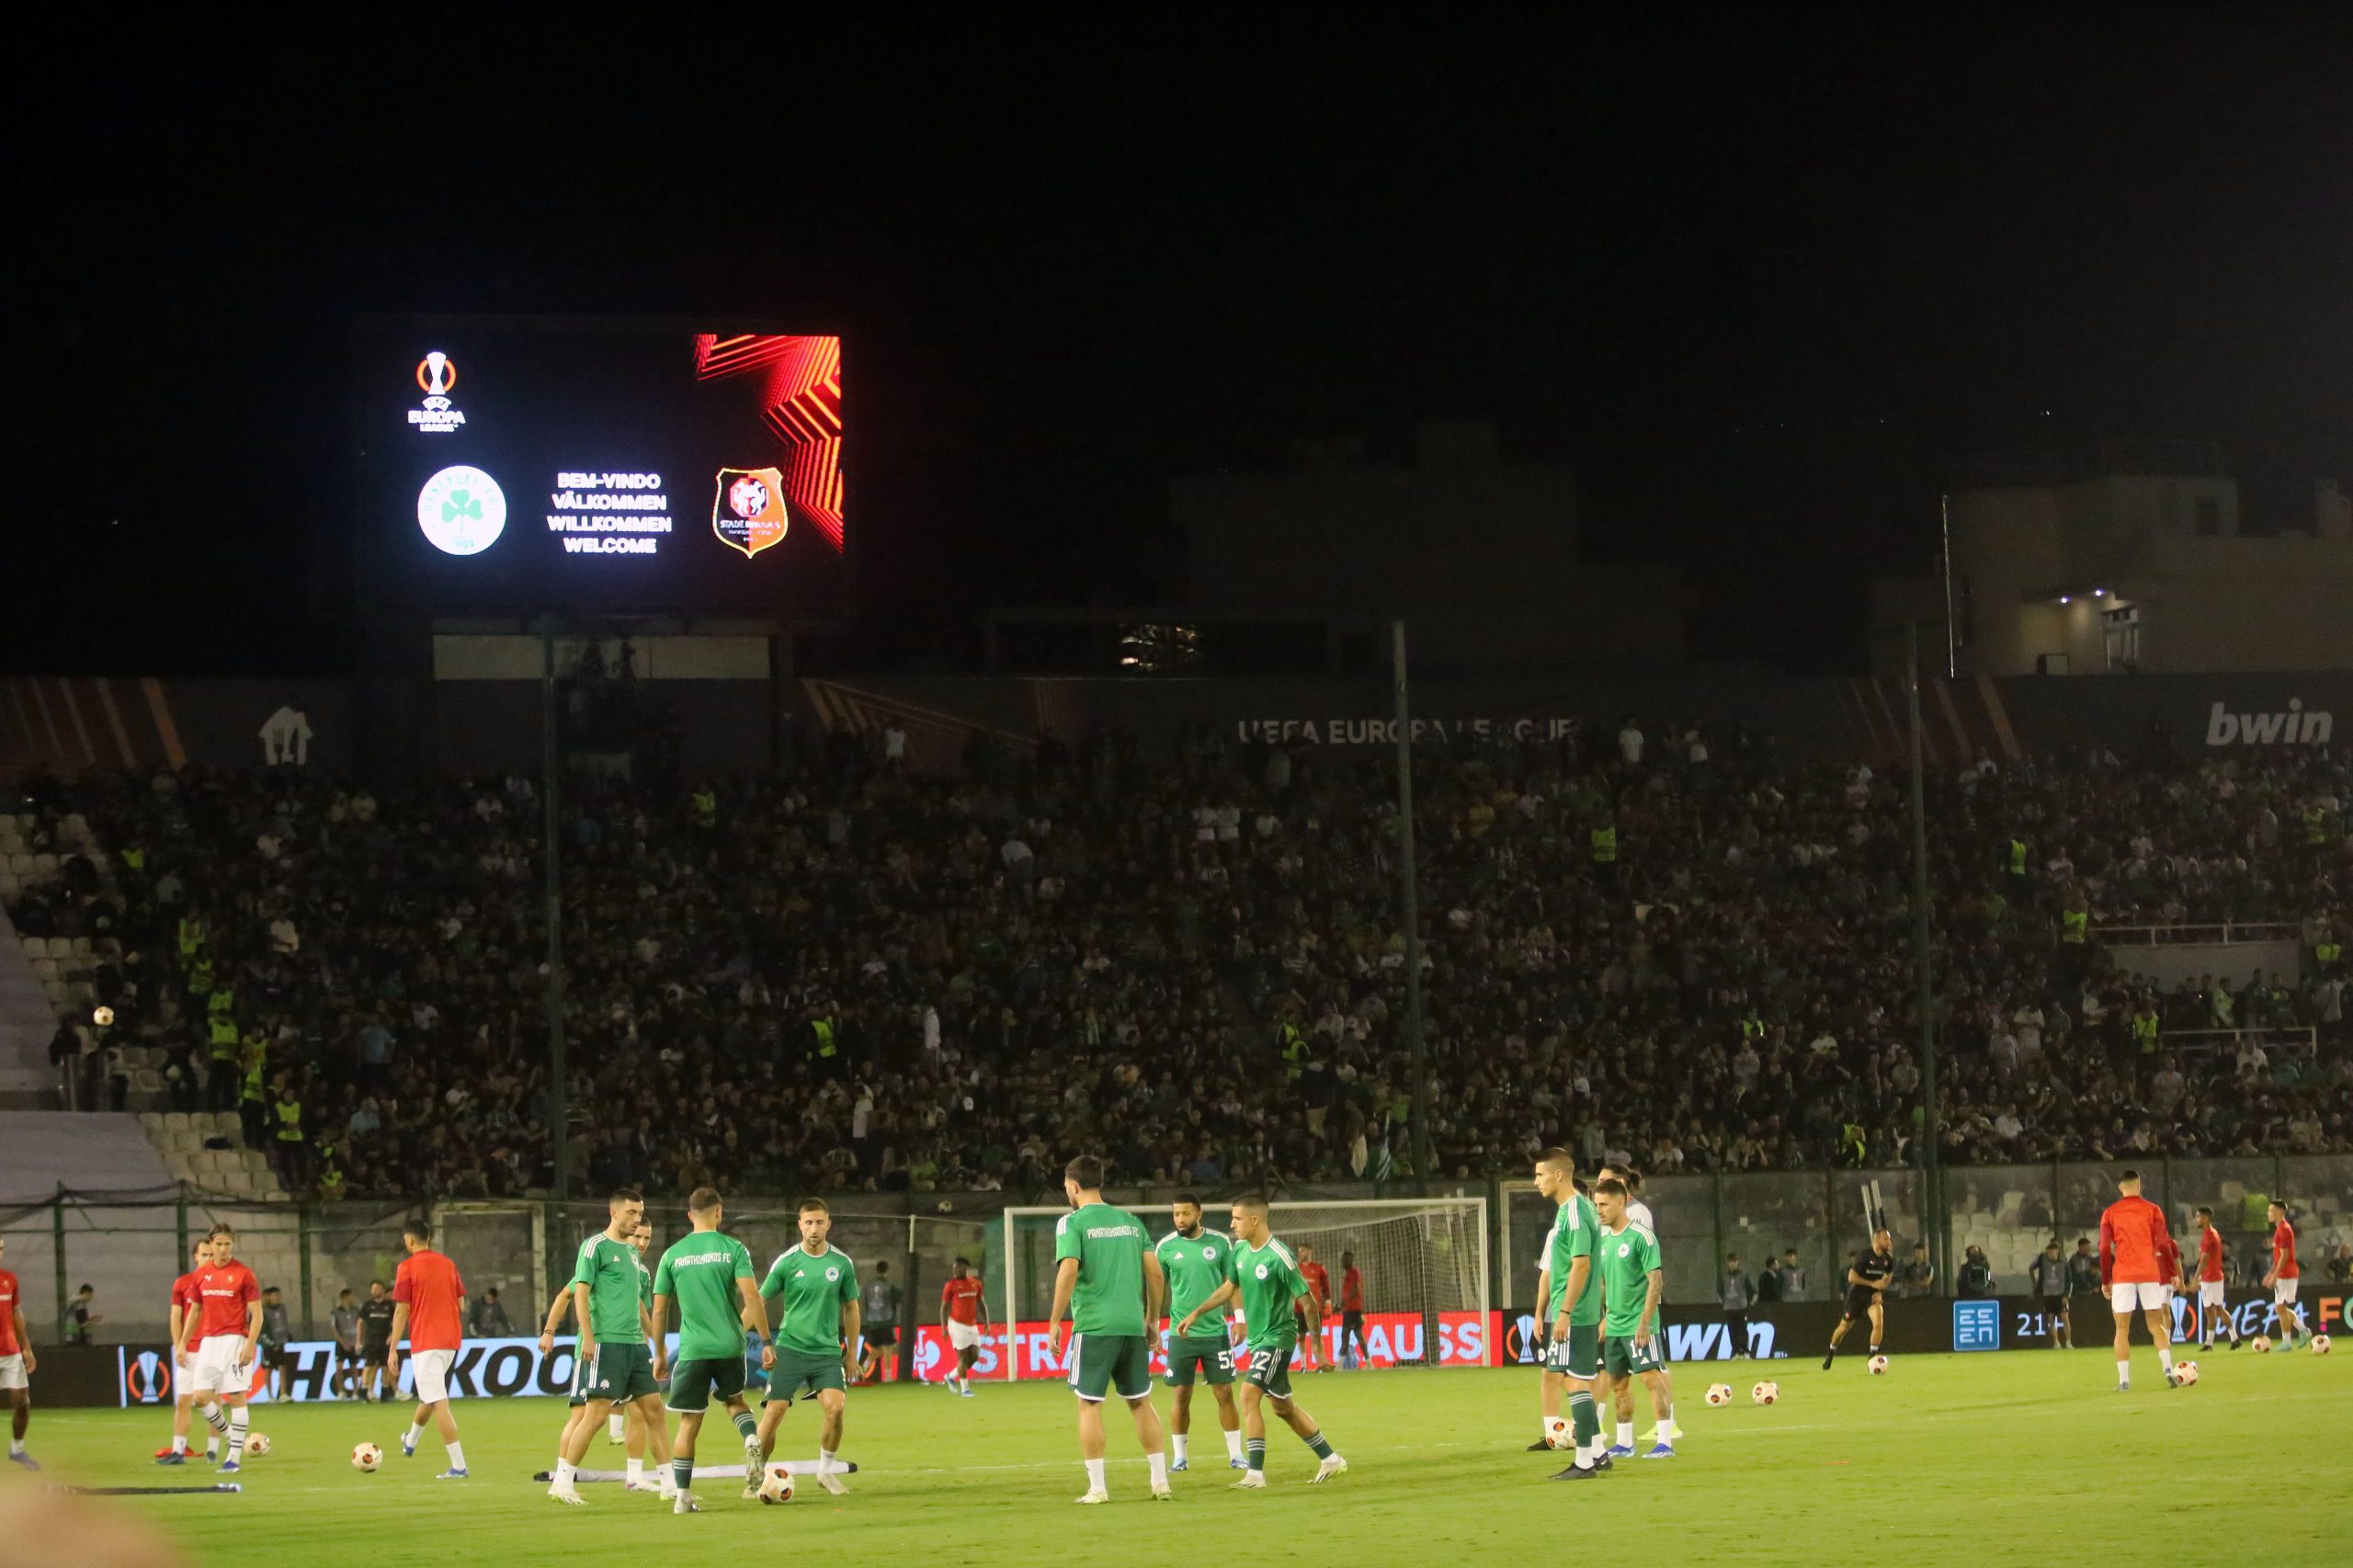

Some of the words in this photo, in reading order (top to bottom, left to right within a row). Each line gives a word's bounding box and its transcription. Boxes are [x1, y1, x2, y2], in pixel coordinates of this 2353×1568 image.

[408, 410, 466, 424] EUROPA
[558, 472, 661, 489] BEM-VINDO
[551, 490, 666, 510] VÄLKOMMEN
[547, 516, 672, 532] WILLKOMMEN
[721, 519, 745, 528] STADE
[563, 538, 657, 553] WELCOME
[2206, 698, 2333, 745] bwin
[723, 1253, 732, 1263] FC
[1664, 1322, 1775, 1361] win
